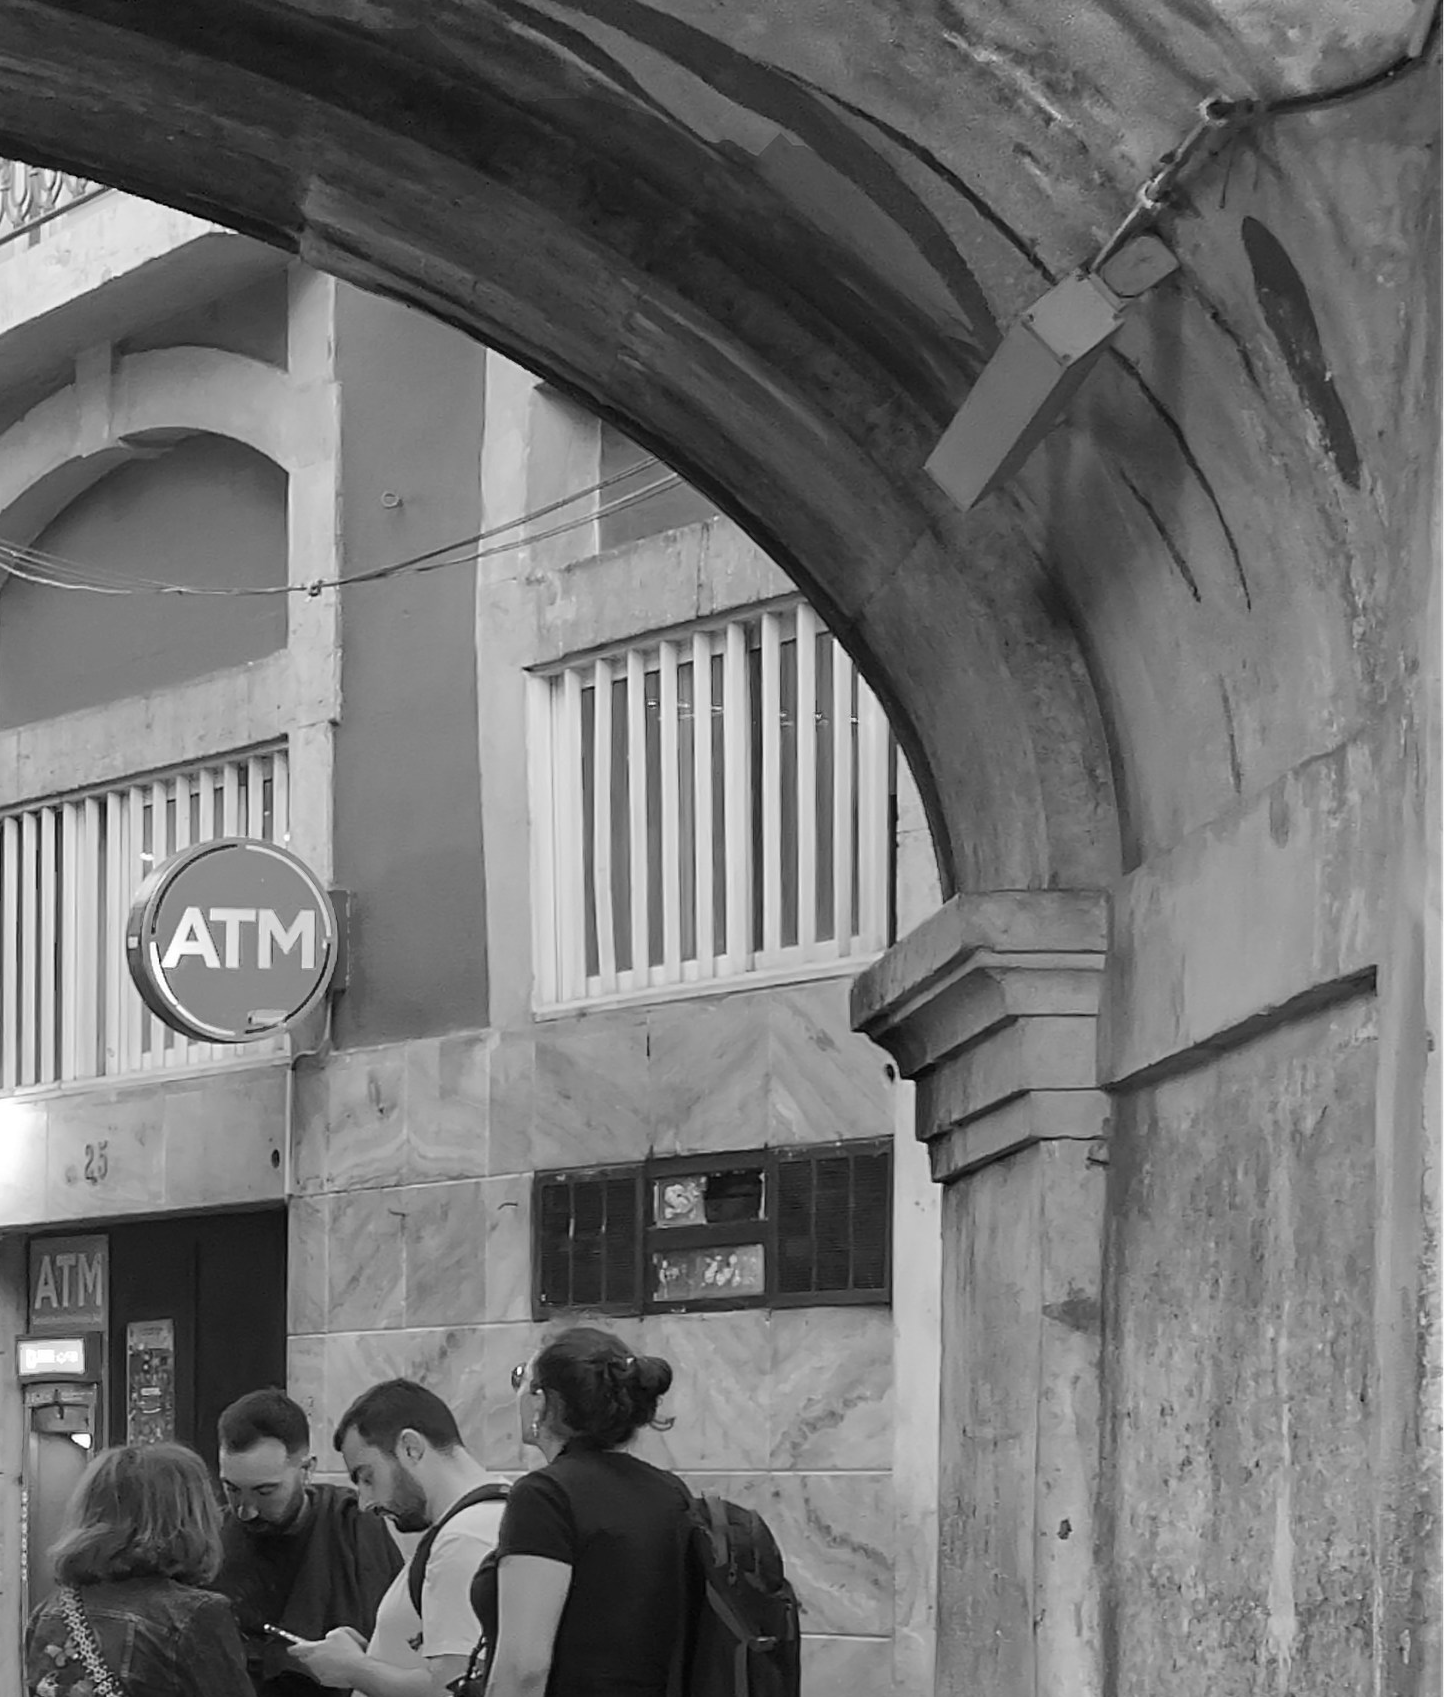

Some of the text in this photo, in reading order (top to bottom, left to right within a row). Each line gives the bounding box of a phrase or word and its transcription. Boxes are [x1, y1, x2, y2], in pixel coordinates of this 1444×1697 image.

[161, 906, 317, 969] ATM
[84, 1140, 108, 1186] 25
[34, 1253, 103, 1310] ATM
